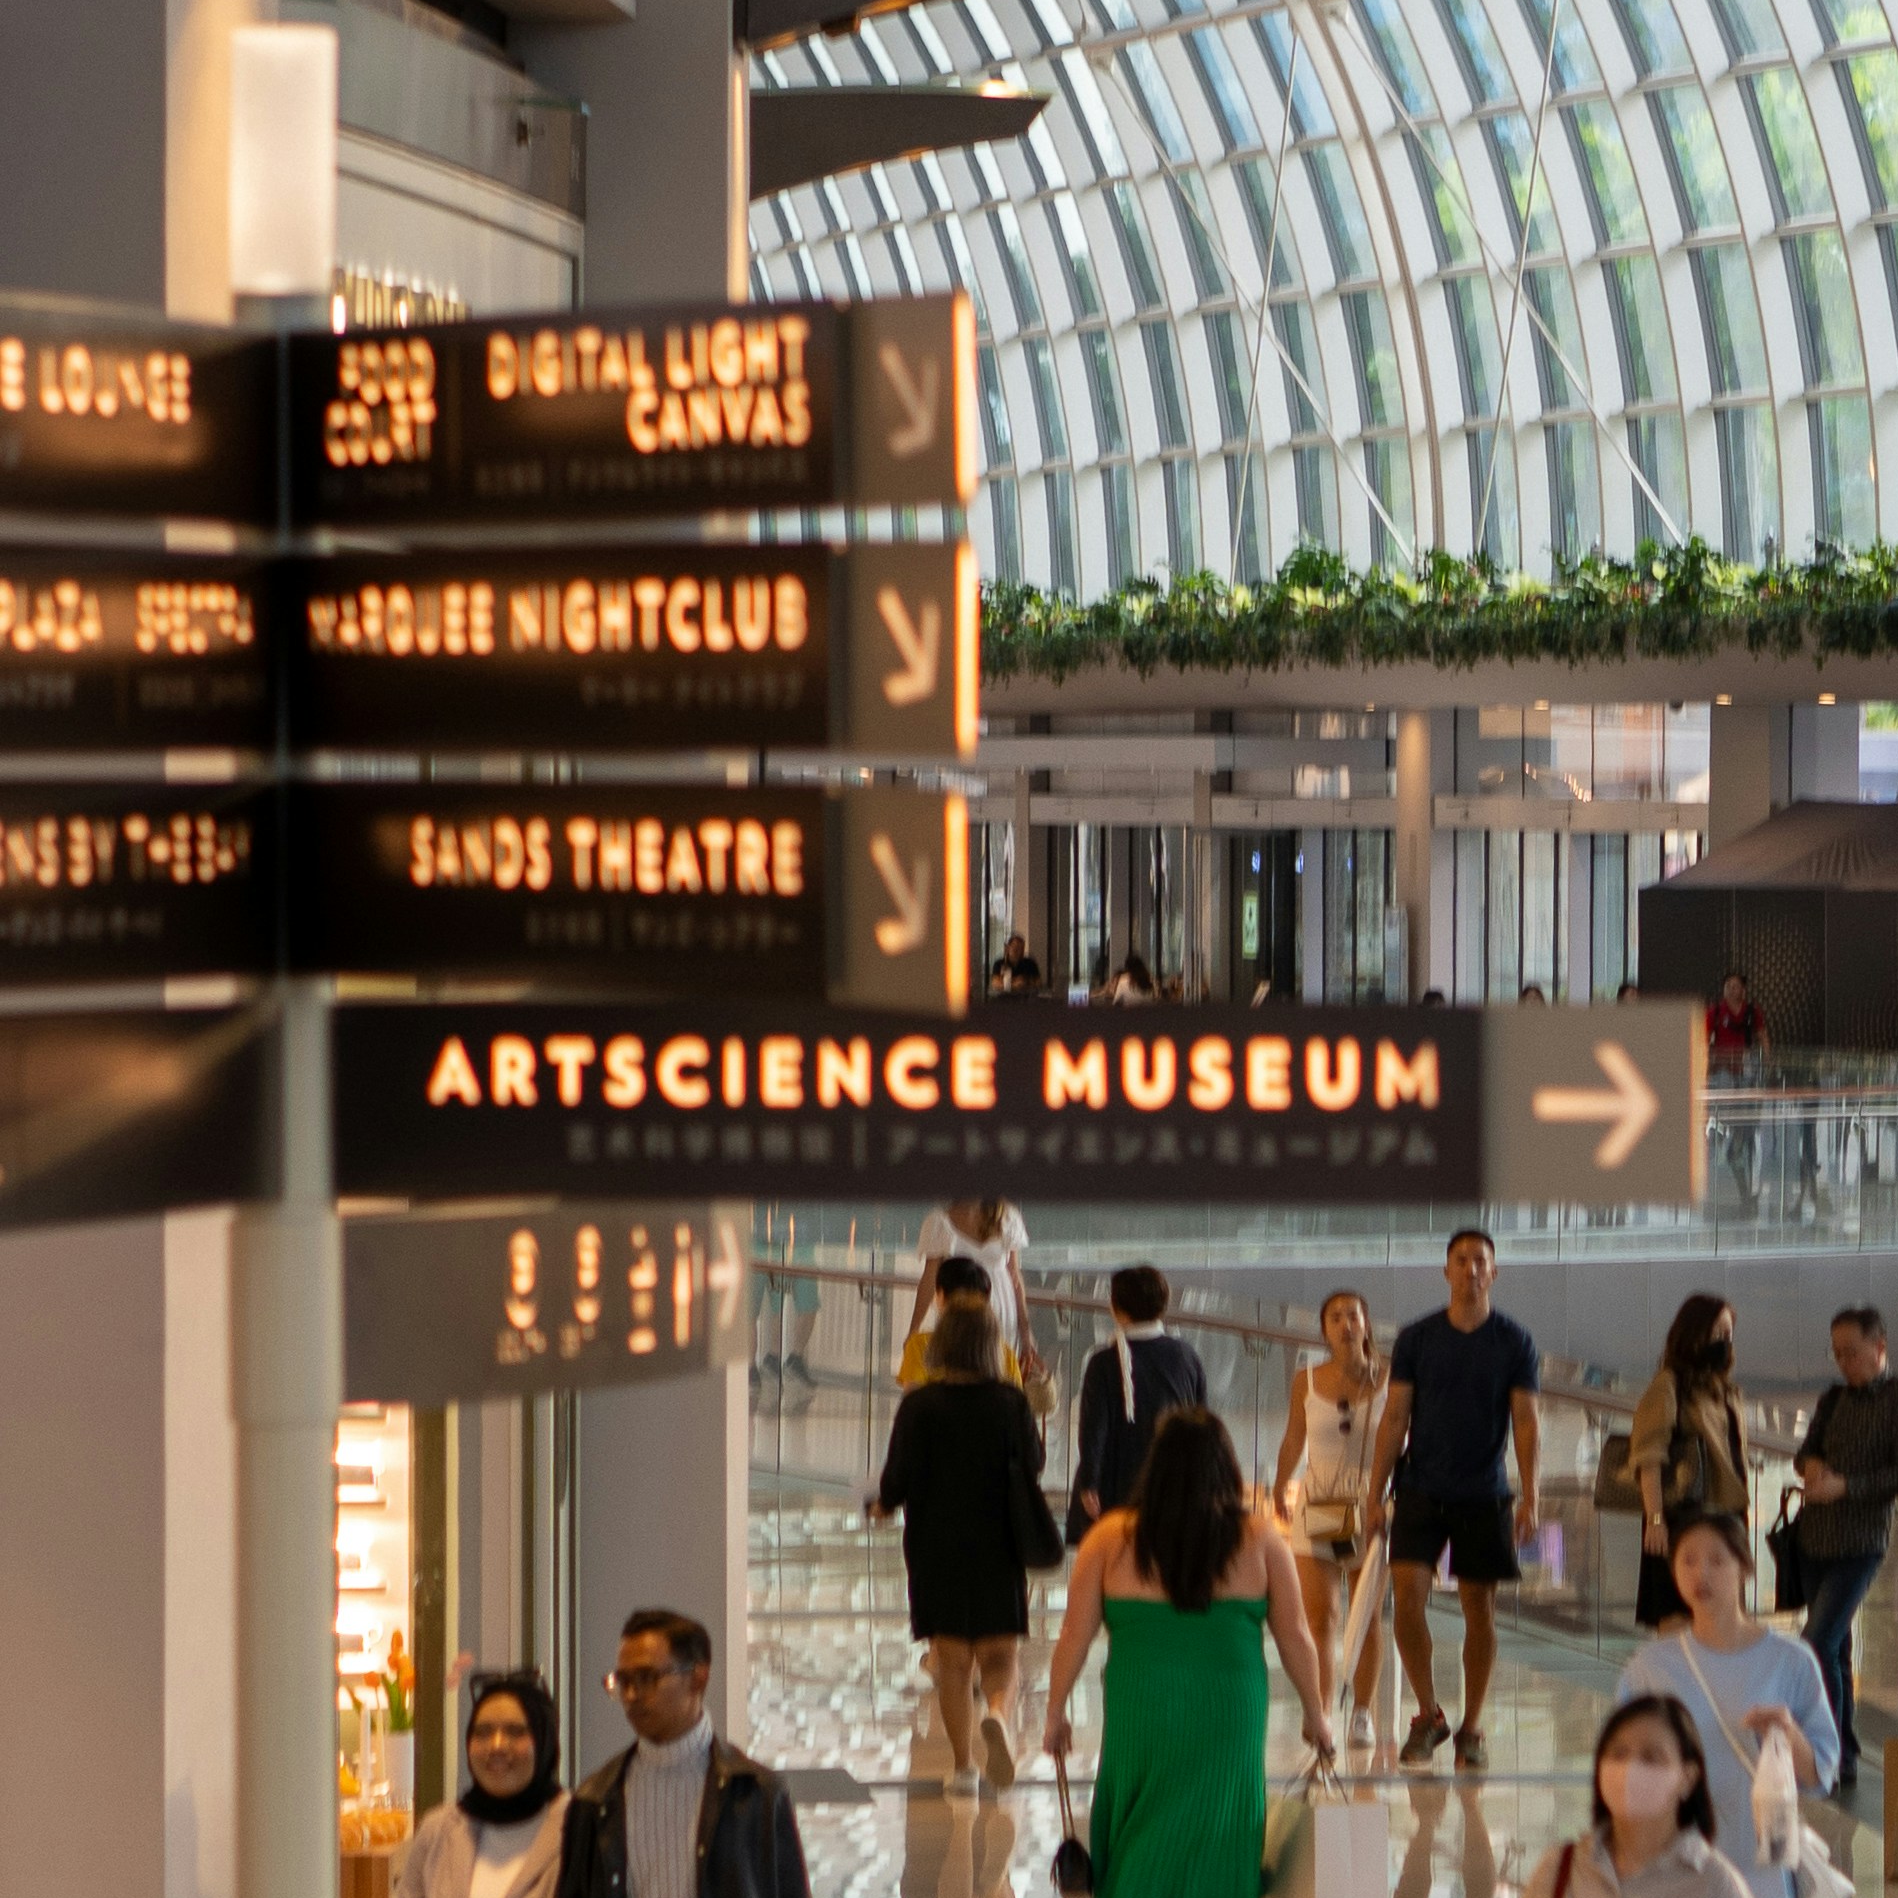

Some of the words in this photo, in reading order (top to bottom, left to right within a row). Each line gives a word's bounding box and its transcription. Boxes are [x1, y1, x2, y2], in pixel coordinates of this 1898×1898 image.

[40, 343, 190, 424] LOUNGE
[338, 335, 436, 405] FOOD
[486, 328, 655, 400] DIGITAL
[664, 315, 810, 389] LIGHT
[324, 399, 437, 466] COURT
[626, 380, 812, 453] CANVAS
[308, 582, 495, 655] MARQUEE
[508, 573, 808, 653] NIGHTCLUB
[0, 815, 60, 889] NS
[410, 815, 553, 892] SANDS
[567, 816, 804, 897] THEATRE
[426, 1033, 998, 1110] ARTSCIENCE
[1043, 1034, 1440, 1111] MUSEUM
